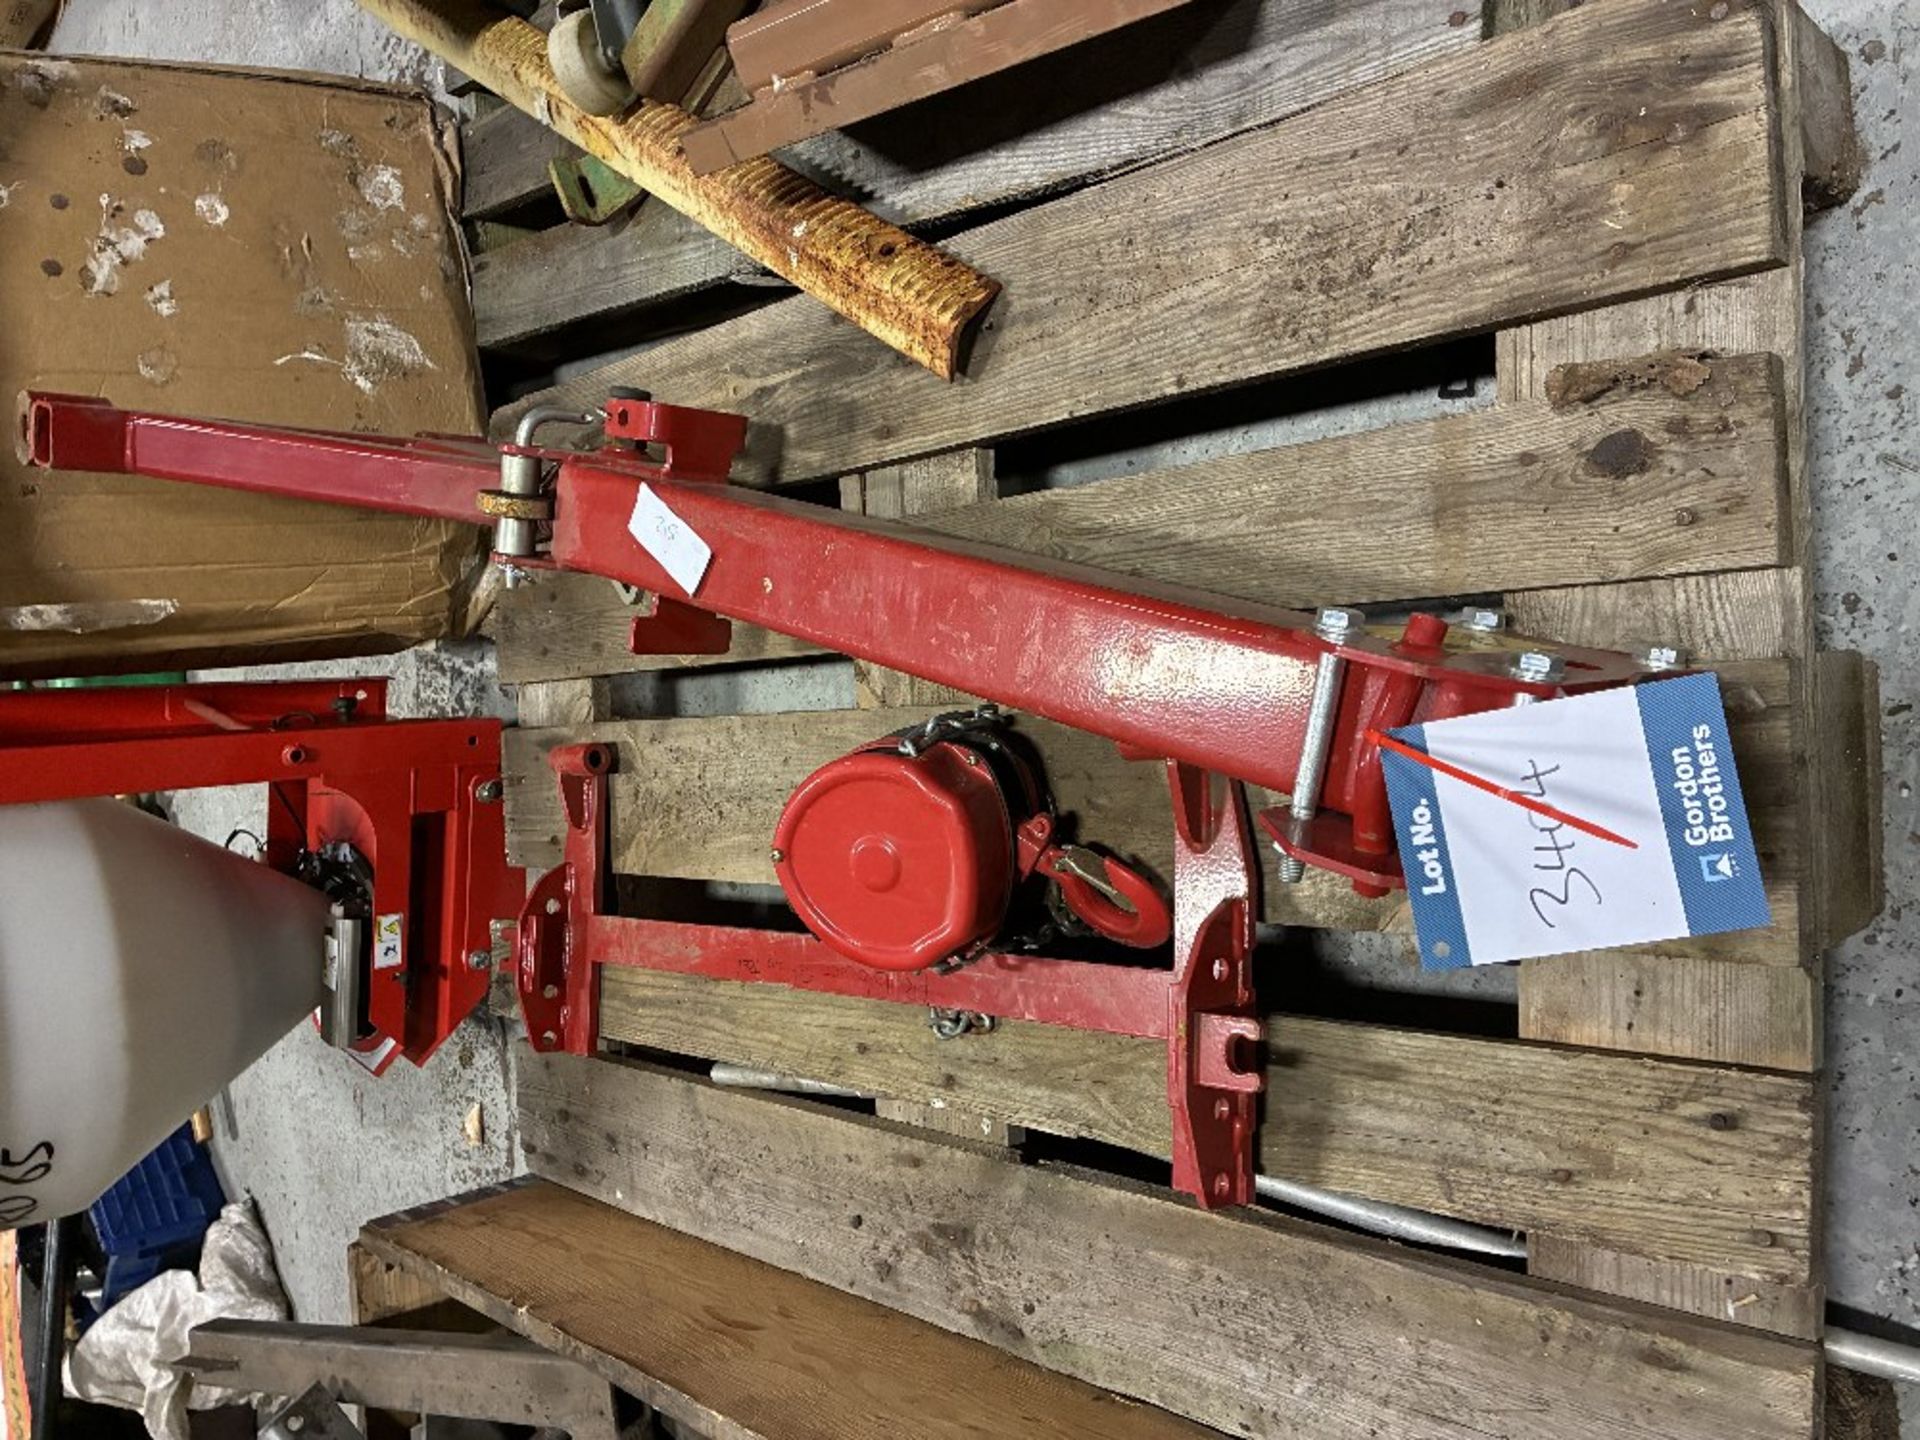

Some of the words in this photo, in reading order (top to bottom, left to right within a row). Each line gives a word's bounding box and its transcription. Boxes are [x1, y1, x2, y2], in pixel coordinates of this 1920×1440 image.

[1671, 745, 1710, 847] Gordon
[1692, 723, 1735, 842] Brothers
[1408, 797, 1433, 846] No.
[1422, 845, 1447, 896] Lot
